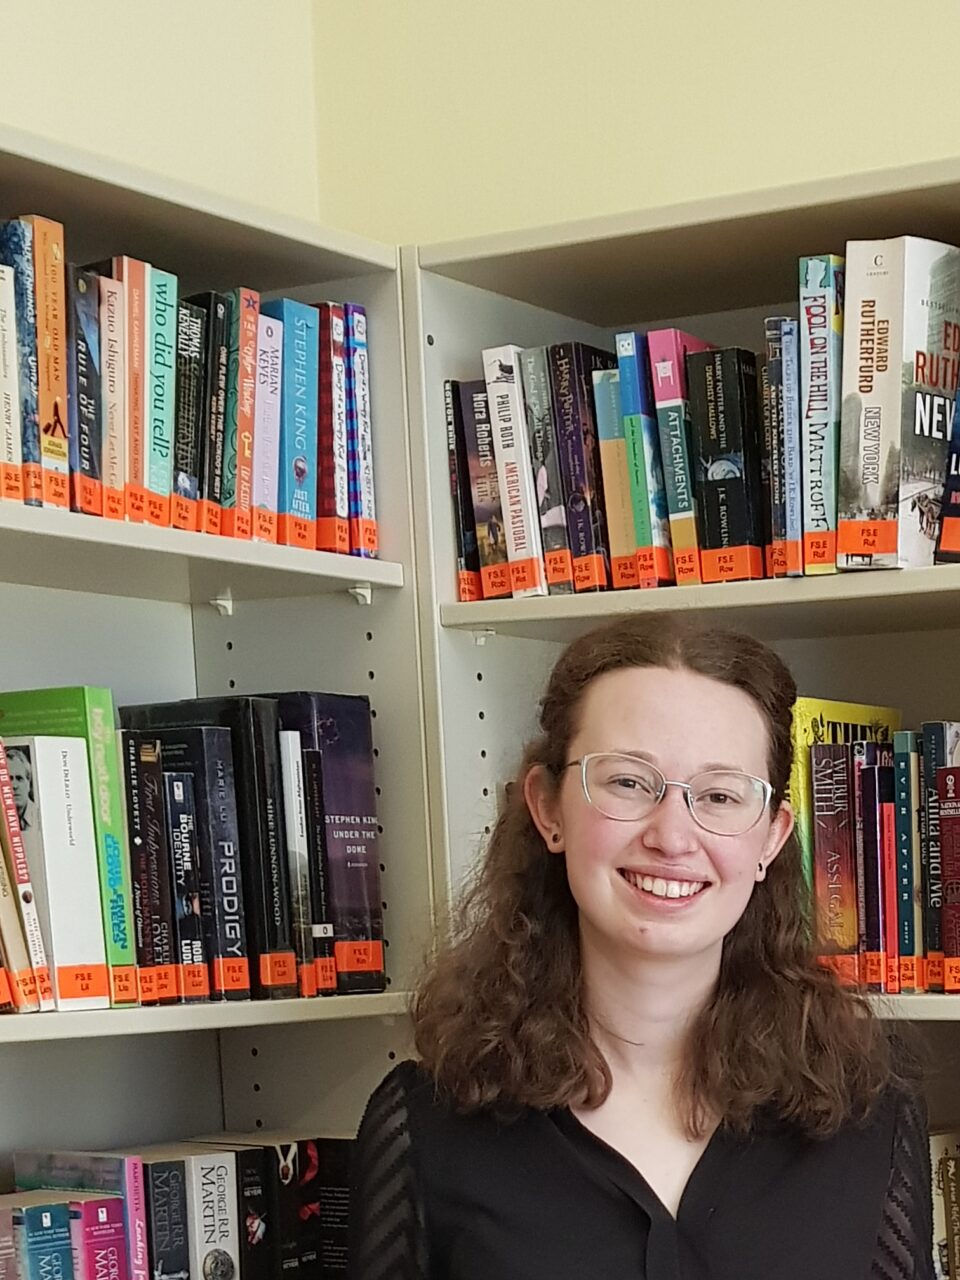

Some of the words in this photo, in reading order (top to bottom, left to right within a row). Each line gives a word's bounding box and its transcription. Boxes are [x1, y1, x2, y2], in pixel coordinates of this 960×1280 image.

[107, 290, 118, 332] Kazuo
[155, 282, 174, 328] who
[803, 294, 826, 333] FOOL
[152, 333, 172, 372] did
[179, 306, 190, 359] KENEALLY
[189, 317, 200, 359] THOMAS
[808, 335, 826, 354] ON
[858, 300, 875, 393] RUTHERFURD
[876, 319, 889, 372] EDWARD
[77, 340, 87, 385] RULE
[106, 336, 119, 393] Ishiguro
[259, 349, 268, 385] KEYES
[270, 347, 278, 395] MARIAN
[293, 317, 307, 400] STEPHEN
[714, 353, 723, 380] HARRY
[810, 356, 827, 379] THE
[79, 392, 88, 417] OF
[150, 374, 172, 406] you
[473, 392, 484, 420] Nora
[497, 394, 512, 429] PHILIP
[716, 382, 725, 413] POTTER
[806, 380, 828, 419] HILL
[152, 411, 170, 458] tell?
[295, 403, 307, 450] KING
[501, 431, 515, 449] ROTH
[717, 413, 726, 431] AND
[718, 432, 727, 449] THE
[863, 407, 881, 435] NEW
[80, 426, 90, 470] FOUR
[475, 422, 492, 467] Roberts
[668, 411, 688, 508] ATTACHMENTS
[810, 423, 828, 479] MATT
[862, 437, 880, 485] YORK
[505, 461, 522, 512] AMERICAN
[809, 481, 830, 532] RUFF
[509, 514, 527, 552] PASTORAL
[719, 565, 734, 573] Row
[129, 739, 137, 785] CHARLIE
[215, 759, 225, 799] MARIE
[145, 772, 158, 811] First
[815, 758, 832, 816] SMITH
[832, 758, 848, 812] WILBUR
[131, 788, 140, 830] LOVETT
[220, 803, 228, 823] LU
[325, 815, 361, 824] STEPHEN
[363, 816, 378, 824] KING
[180, 814, 191, 870] BOURNE
[333, 830, 359, 839] UNDER
[362, 830, 376, 838] THE
[149, 814, 160, 905] Impressions
[173, 828, 186, 886] IDENTITY
[268, 822, 281, 926] LUNNON-WOOD
[218, 841, 242, 956] PRODIGY
[153, 1172, 170, 1251] MARTIN
[201, 1166, 216, 1244] MARTIN
[216, 1165, 228, 1216] GEORGE
